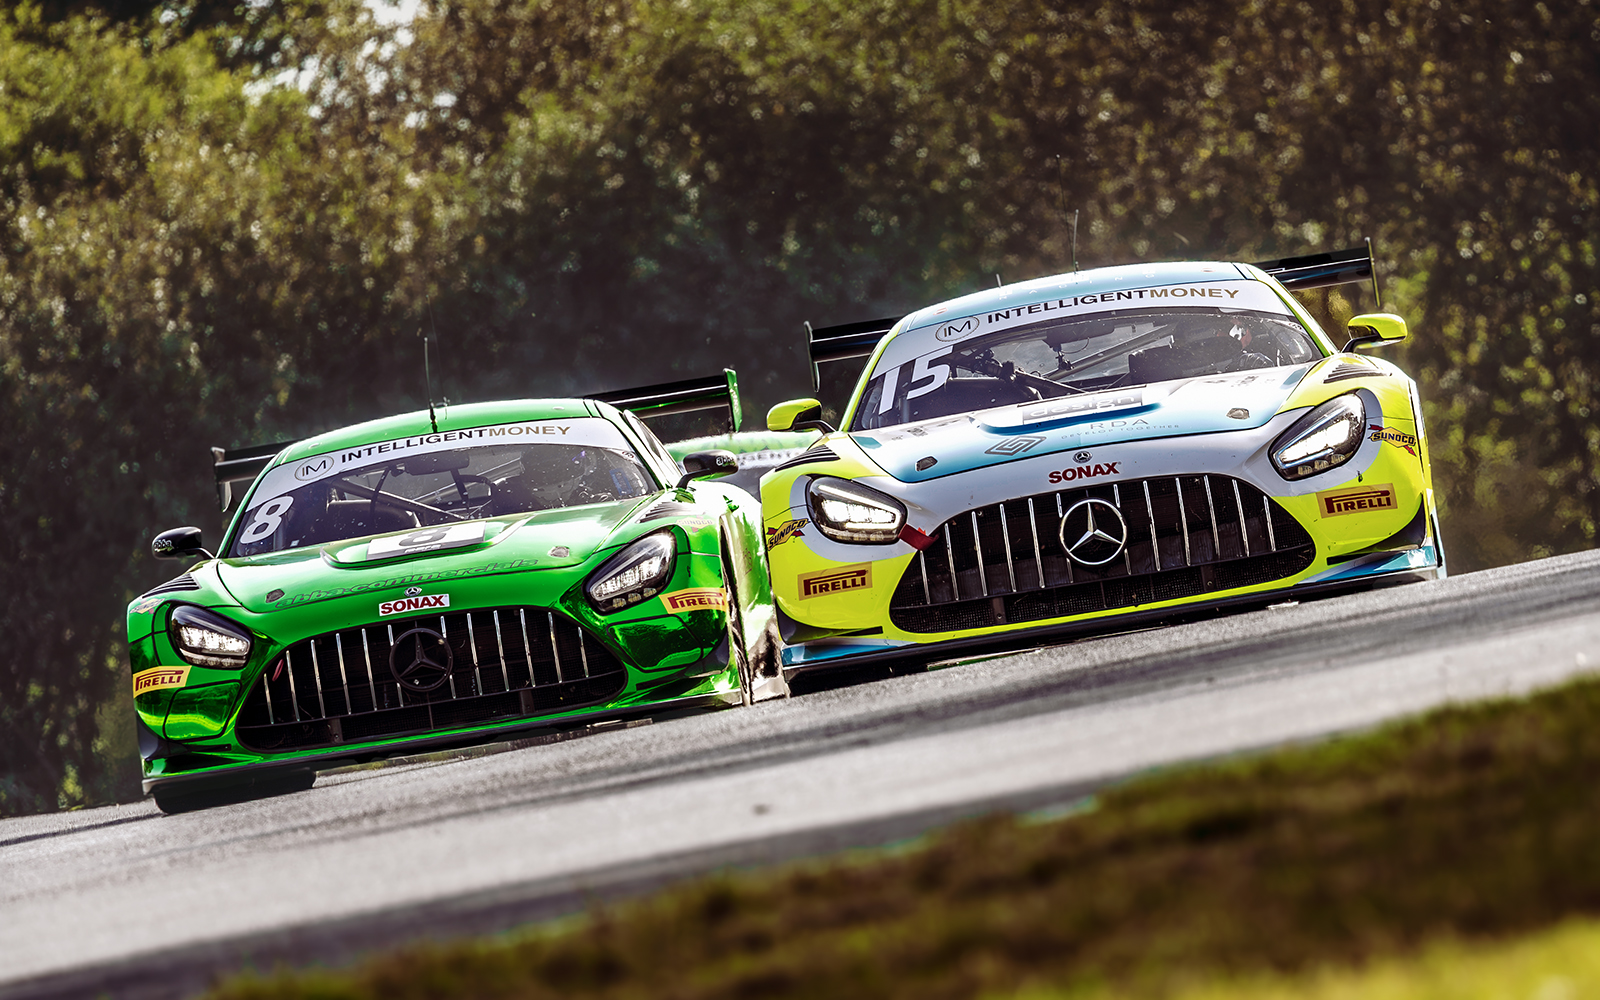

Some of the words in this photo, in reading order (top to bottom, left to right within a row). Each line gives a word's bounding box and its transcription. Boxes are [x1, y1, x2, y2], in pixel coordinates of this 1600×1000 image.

[943, 320, 971, 338] IM
[878, 344, 954, 415] 15
[1030, 395, 1135, 417] design
[1090, 418, 1149, 430] RDA
[1373, 431, 1415, 445] SUNOCO
[302, 459, 327, 477] IM
[1048, 461, 1120, 484] SONAX
[1324, 489, 1392, 514] PIRELLI
[240, 495, 294, 544] 8
[398, 526, 453, 547] 8
[768, 518, 810, 548] SUNOCO
[803, 569, 867, 596] PIRELLI
[380, 594, 446, 615] SONAX
[667, 591, 726, 609] PIRELLI
[135, 670, 184, 691] PIRELLI
